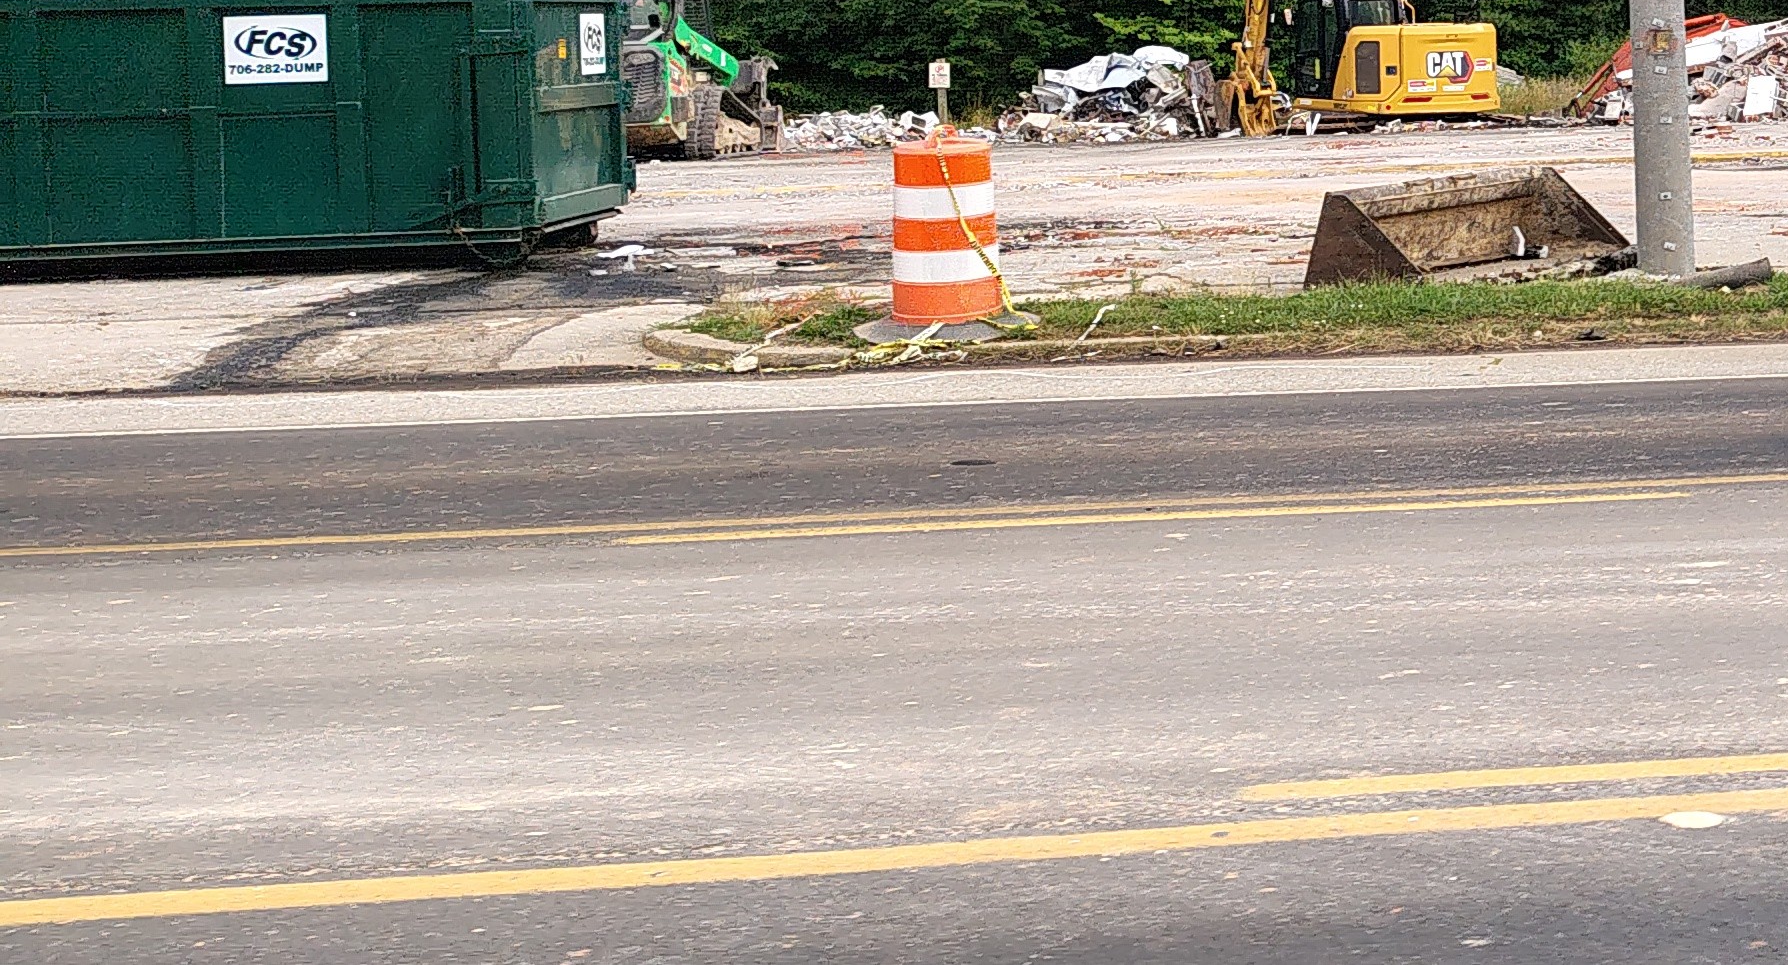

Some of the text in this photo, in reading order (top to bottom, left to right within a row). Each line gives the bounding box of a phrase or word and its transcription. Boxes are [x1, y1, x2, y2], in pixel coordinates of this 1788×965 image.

[245, 29, 307, 58] FCS
[228, 62, 323, 75] 706-282-DUMP
[1427, 51, 1464, 77] CAT
